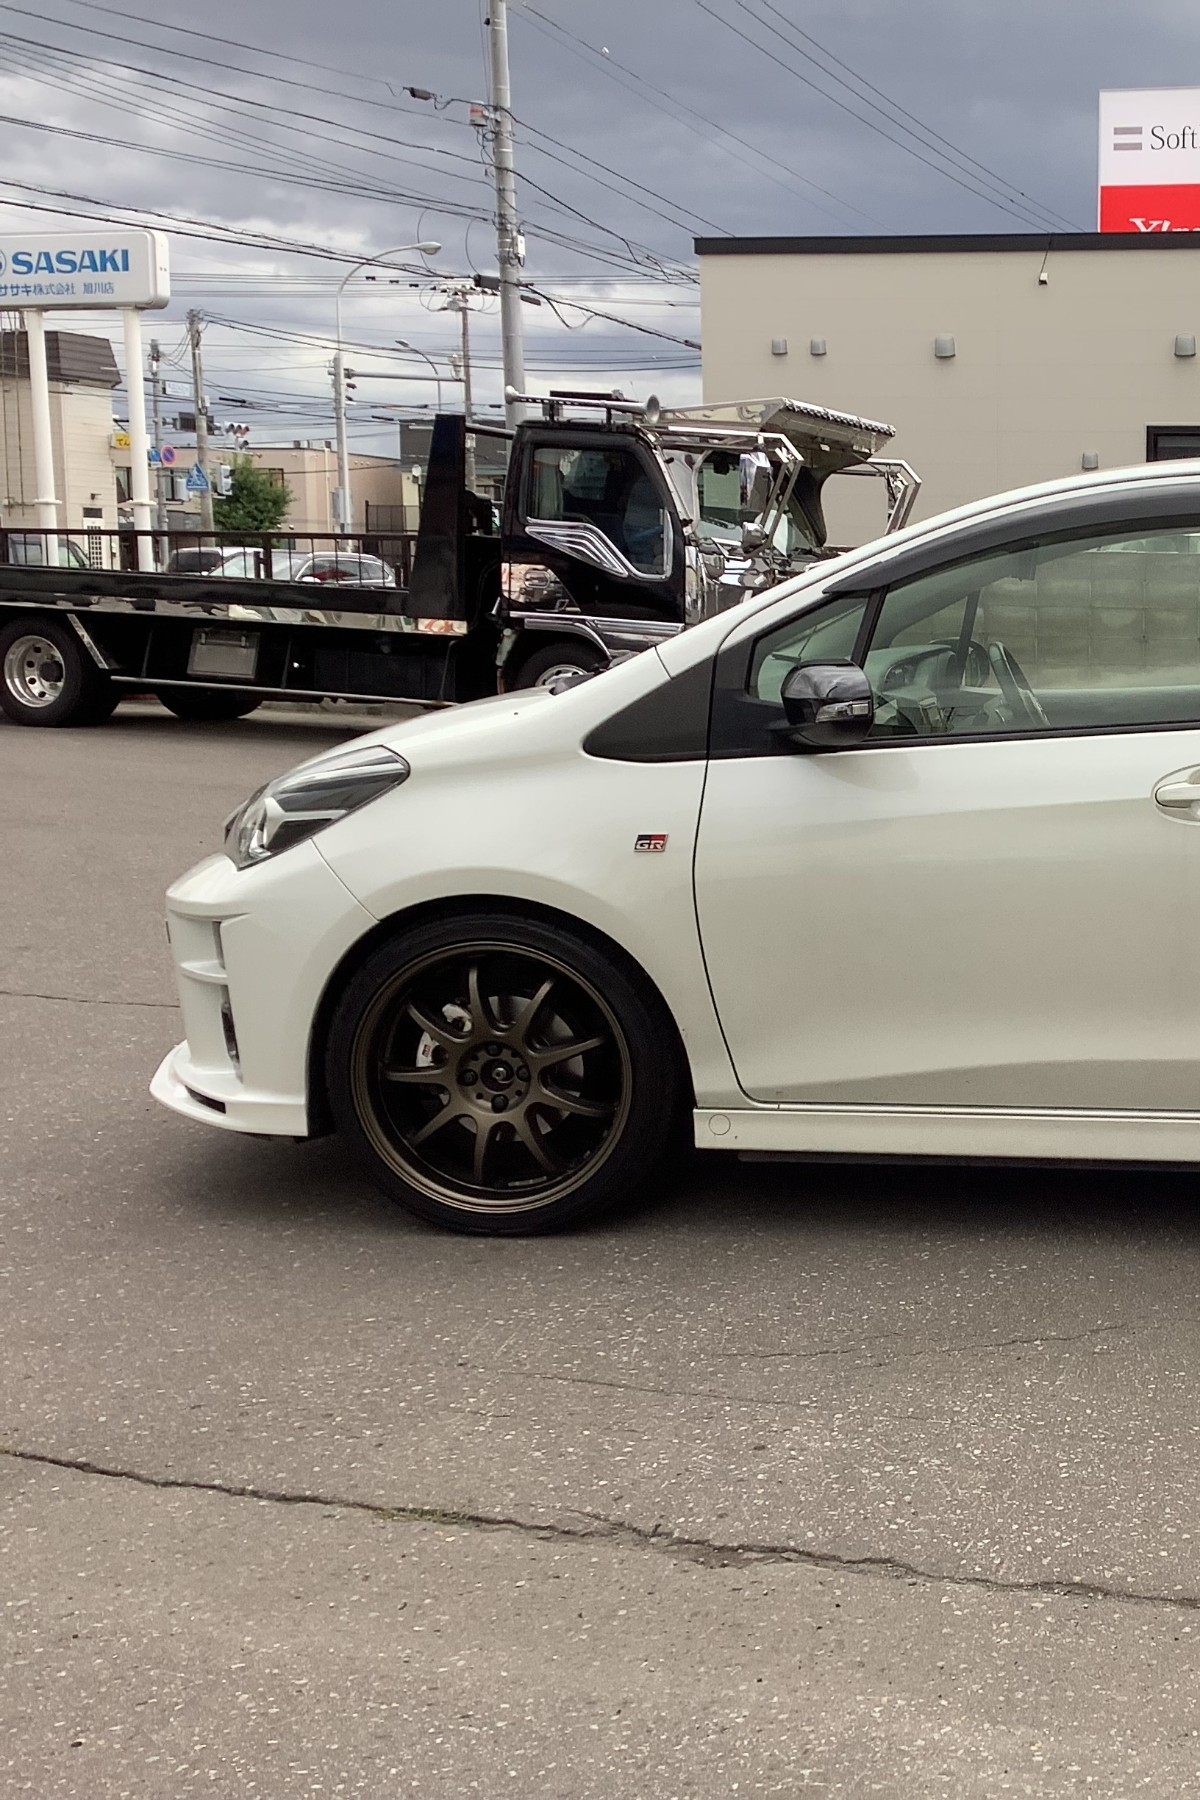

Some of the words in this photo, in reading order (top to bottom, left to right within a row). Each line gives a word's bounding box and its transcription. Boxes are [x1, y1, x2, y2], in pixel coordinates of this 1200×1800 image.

[12, 249, 129, 275] SASAKI
[0, 282, 76, 297] ササキ株式会社
[83, 282, 115, 295] 旭川店
[636, 840, 664, 850] GR
